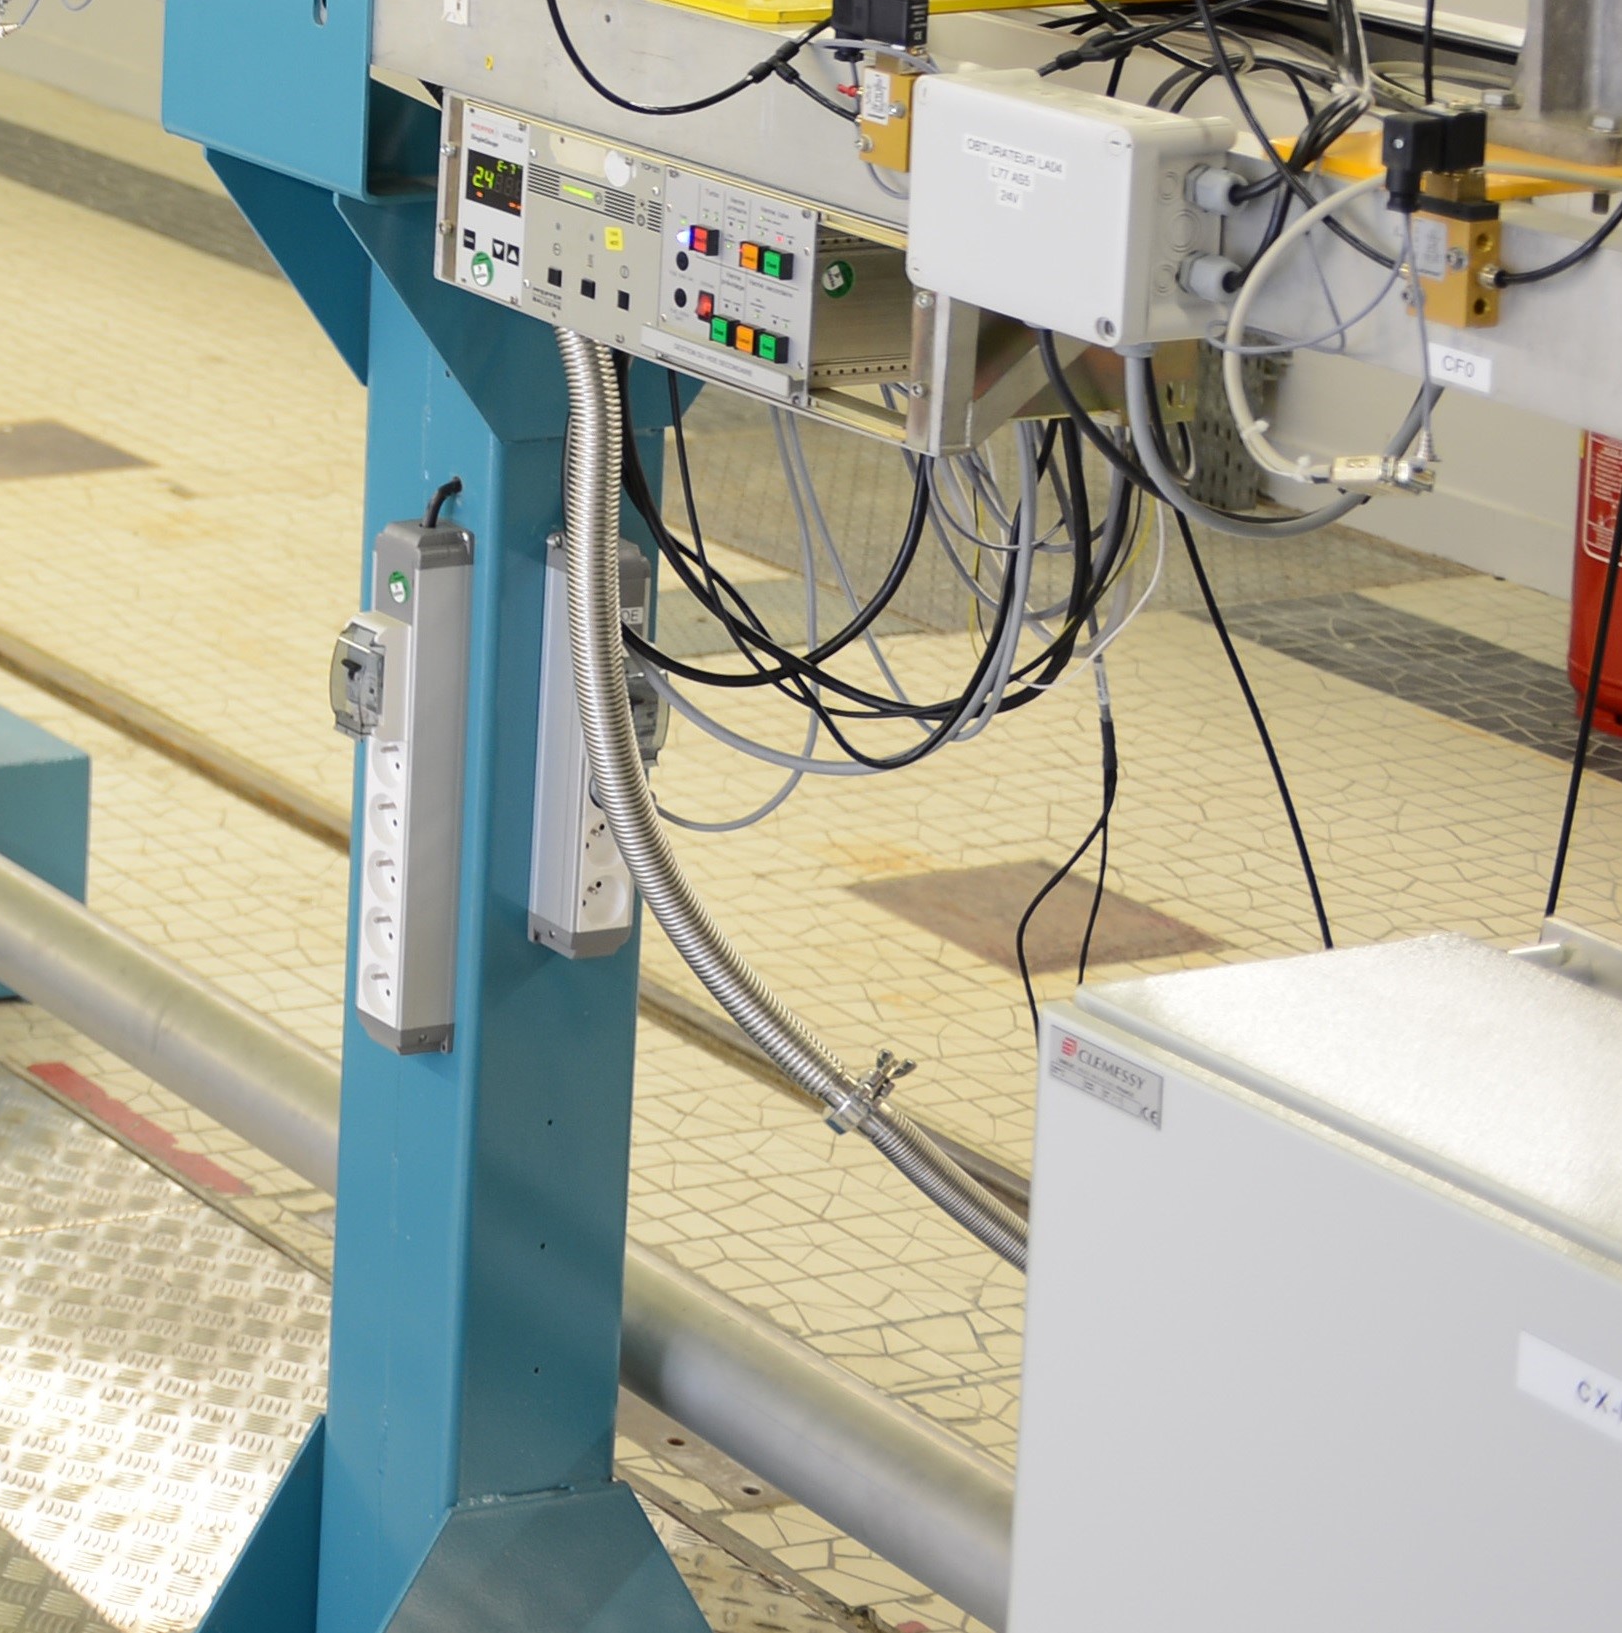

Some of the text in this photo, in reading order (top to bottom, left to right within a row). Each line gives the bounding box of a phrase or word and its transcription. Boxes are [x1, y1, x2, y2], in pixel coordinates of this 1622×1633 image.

[1443, 354, 1475, 378] CF0
[1078, 1049, 1145, 1090] CLEMESSY
[1577, 1380, 1622, 1422] CX-
